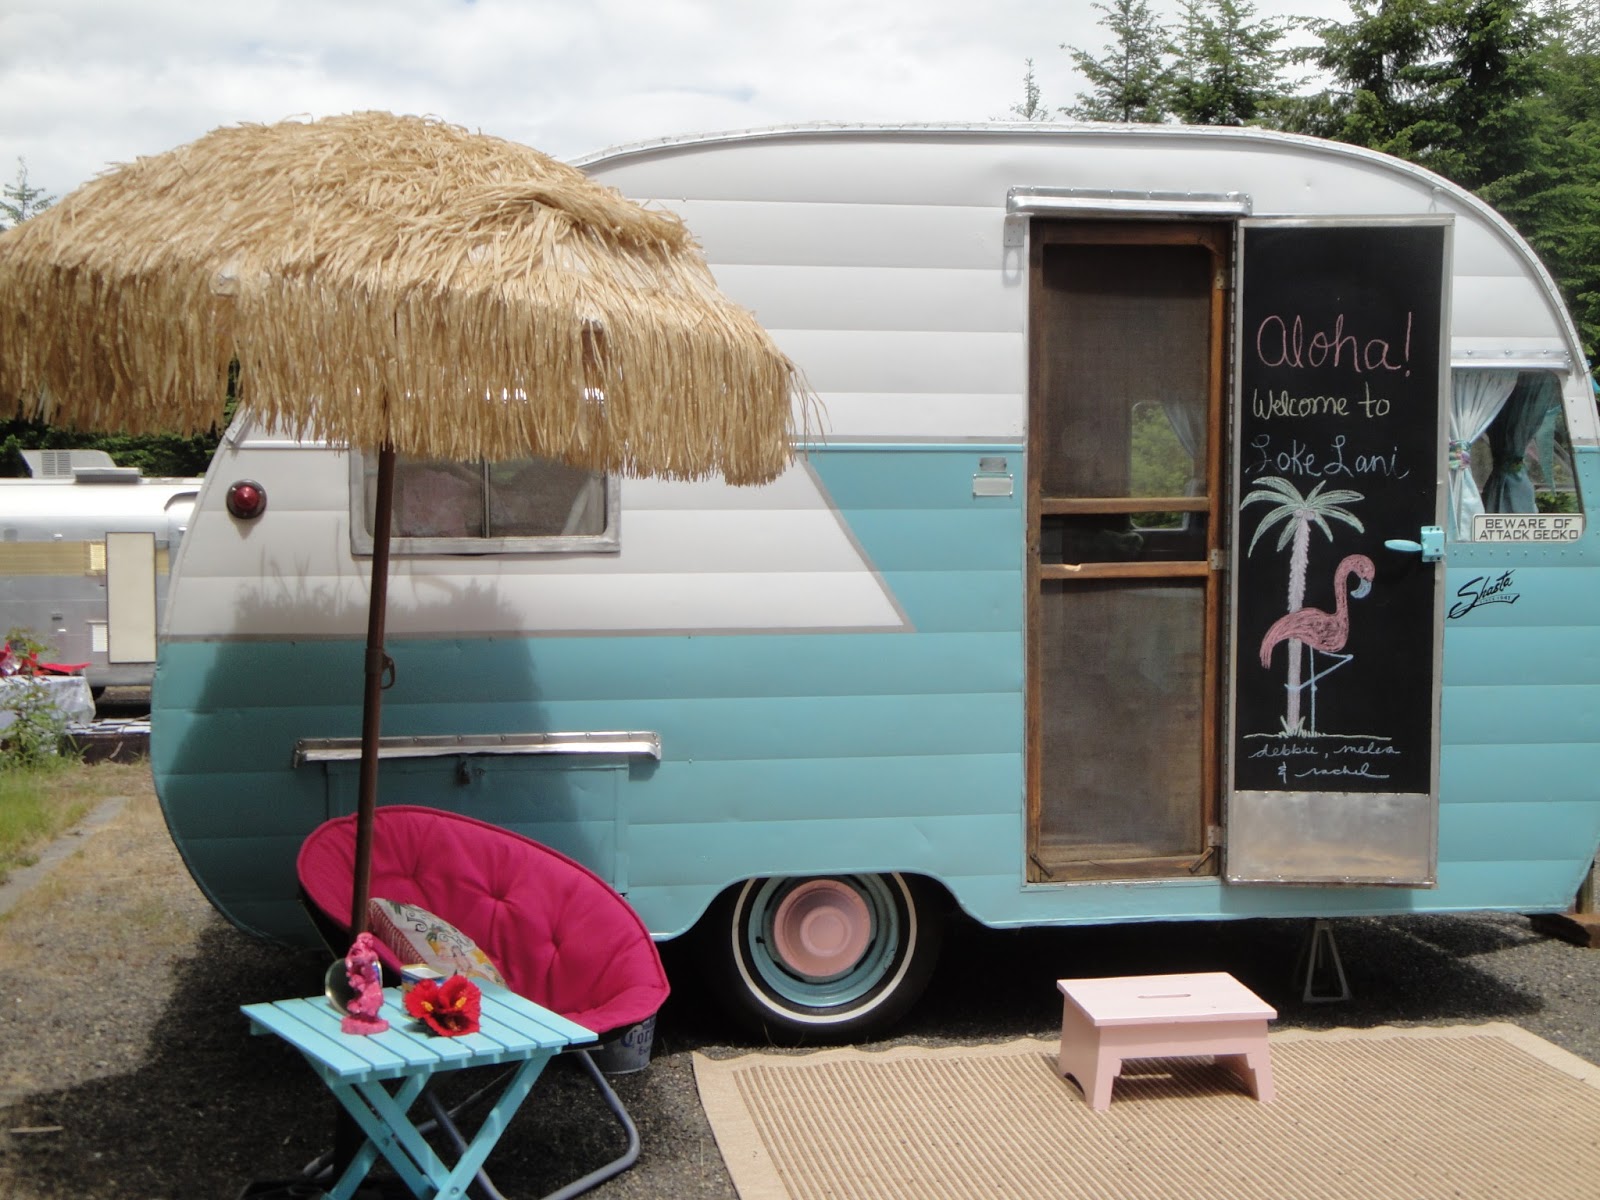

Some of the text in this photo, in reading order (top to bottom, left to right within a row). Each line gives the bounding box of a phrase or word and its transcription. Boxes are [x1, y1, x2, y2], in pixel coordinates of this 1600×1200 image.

[1256, 311, 1412, 377] Aloha!
[1252, 381, 1391, 420] Welcome to
[1323, 434, 1410, 479] Lani
[1479, 529, 1579, 540] ATTACK GECKO
[1485, 518, 1573, 529] BEWARE OF
[1447, 568, 1516, 619] Shasta
